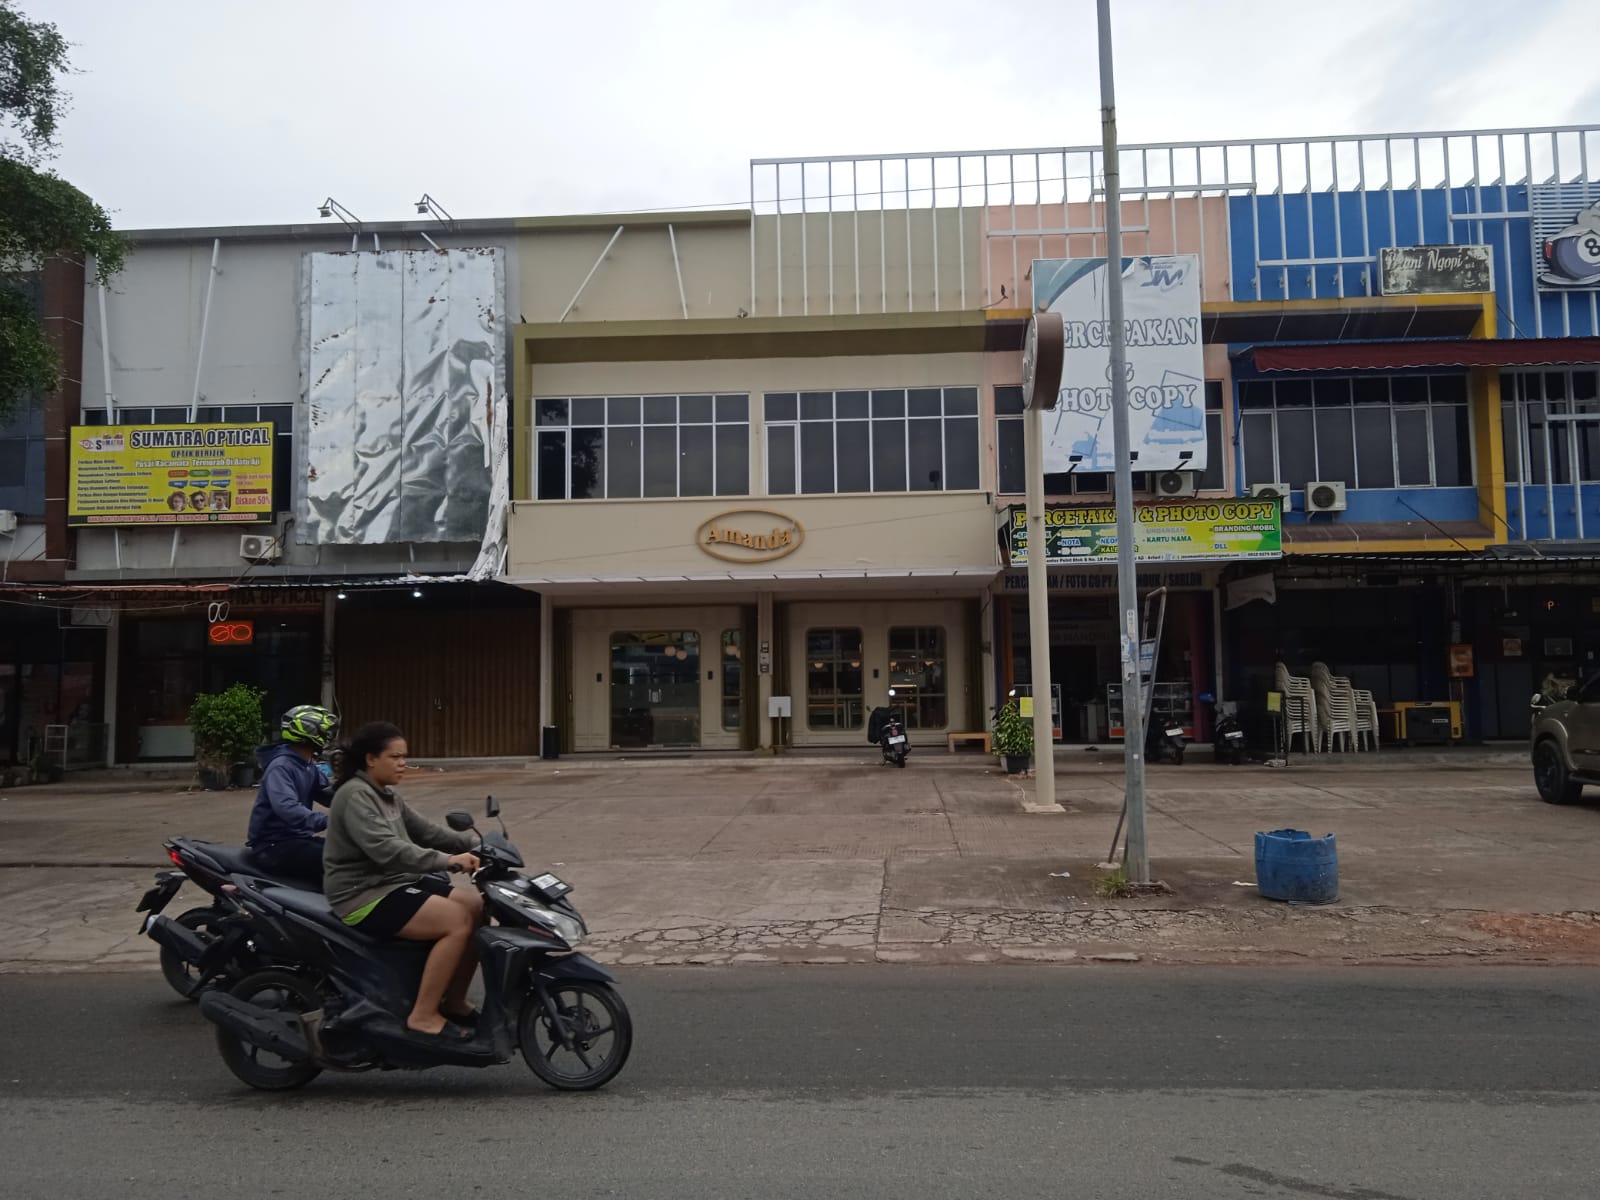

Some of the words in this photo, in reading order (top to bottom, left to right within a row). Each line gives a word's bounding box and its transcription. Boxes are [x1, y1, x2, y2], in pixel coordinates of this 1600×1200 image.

[1427, 248, 1463, 271] Ngopi
[131, 430, 203, 447] SUMATRA
[205, 428, 270, 446] OPTICAL
[1139, 507, 1154, 522] &
[1156, 504, 1220, 522] PHOTO
[1222, 502, 1274, 520] COPY
[705, 523, 793, 551] Amanda
[1213, 524, 1251, 532] BRANDING
[1060, 538, 1081, 546] NOTA
[1146, 535, 1169, 543] KARTU
